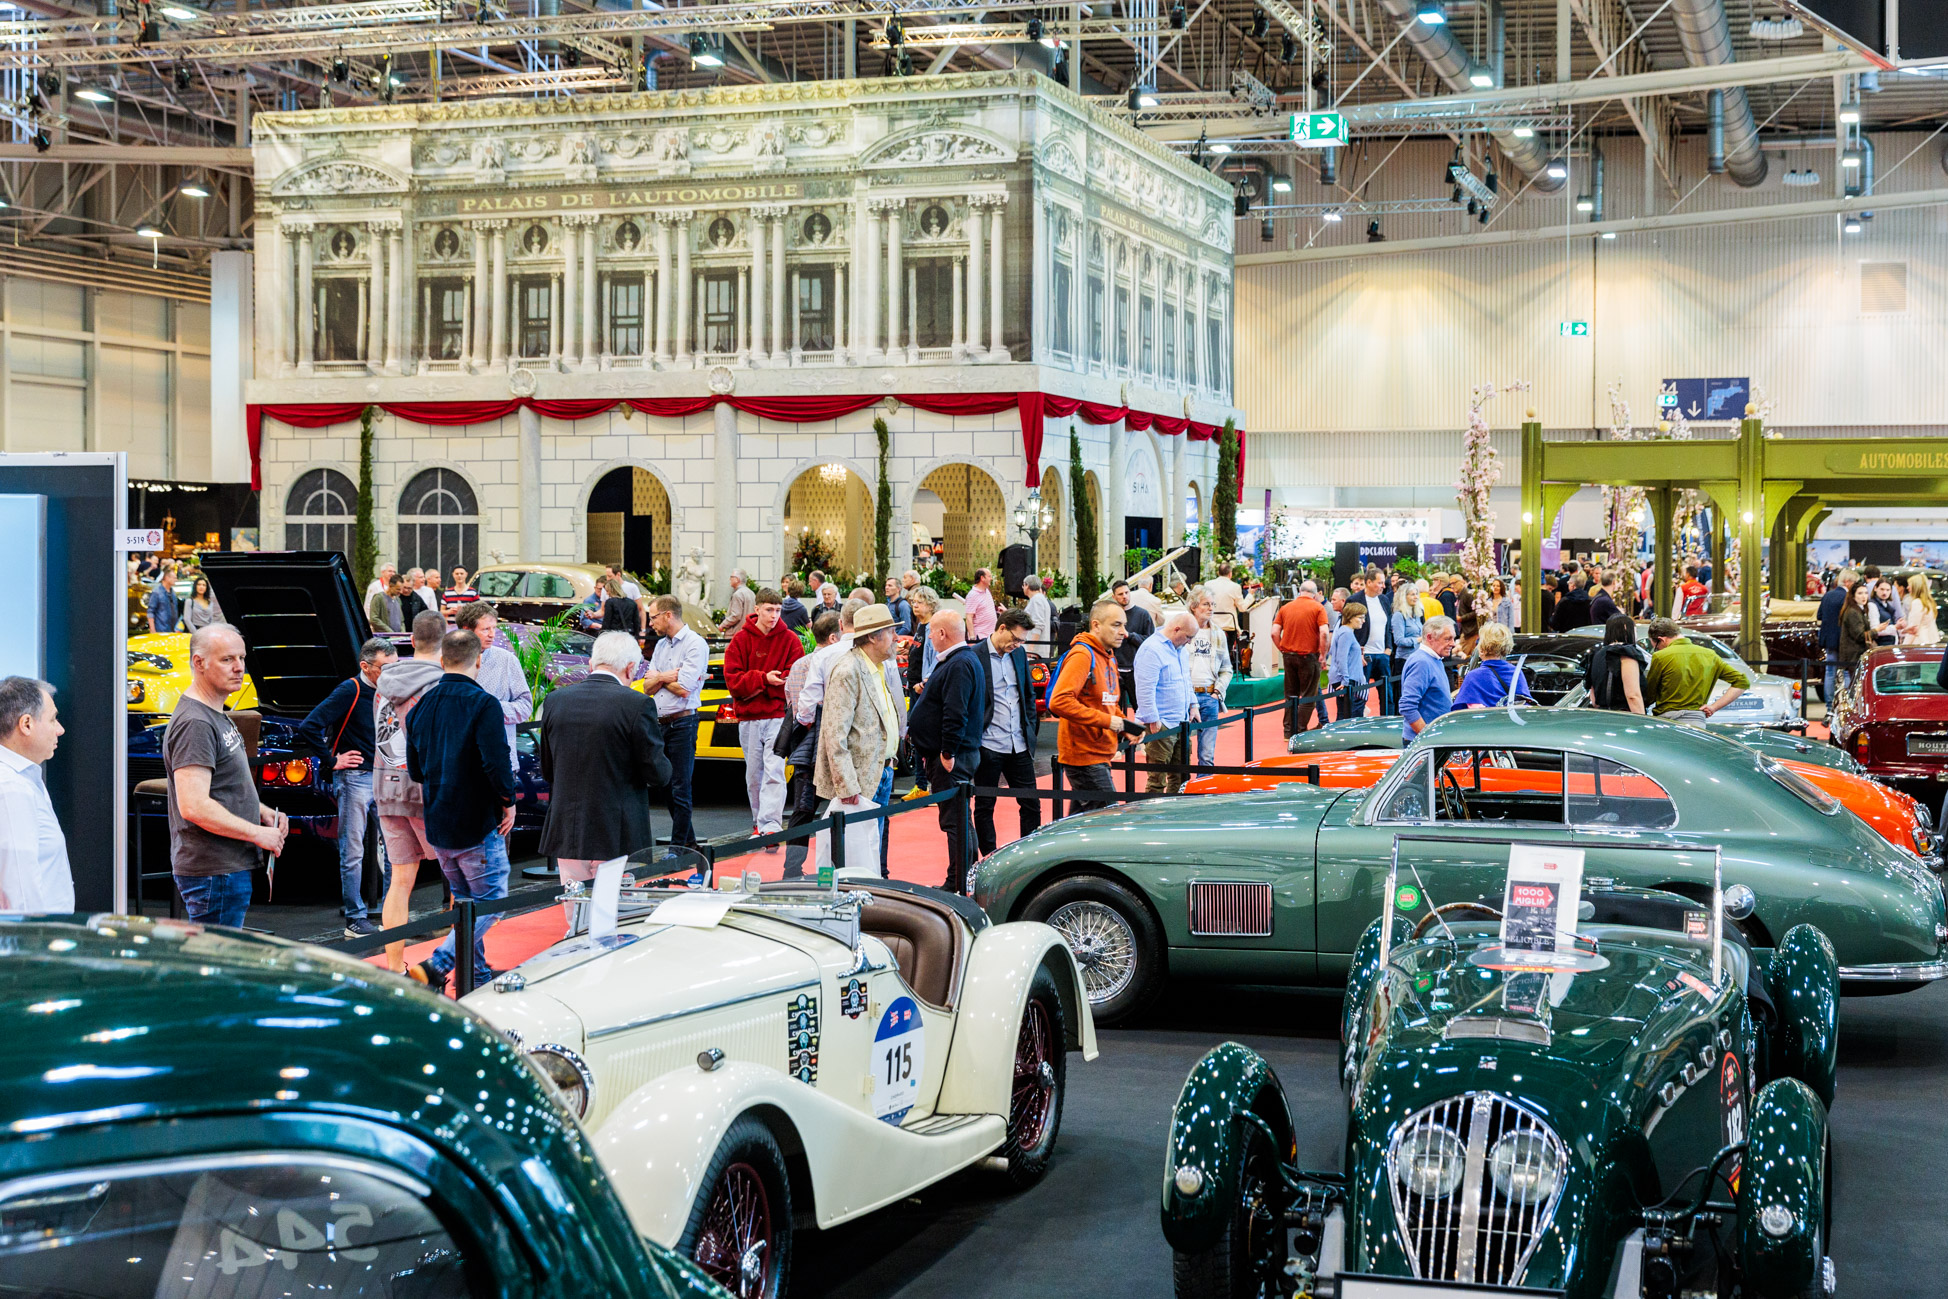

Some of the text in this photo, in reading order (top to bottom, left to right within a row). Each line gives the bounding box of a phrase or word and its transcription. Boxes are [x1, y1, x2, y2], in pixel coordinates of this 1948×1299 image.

[463, 184, 798, 211] PALAIS DE L'AUTOMOBILE
[1101, 204, 1126, 226] PALAIS
[1130, 218, 1139, 231] DE
[1860, 453, 1948, 469] AUTOMOBILES
[1360, 546, 1397, 556] DDCLASSIC
[1514, 897, 1545, 906] MIGLIA
[1518, 888, 1544, 897] 1000
[886, 1041, 911, 1085] 115
[1727, 1102, 1743, 1147] 182
